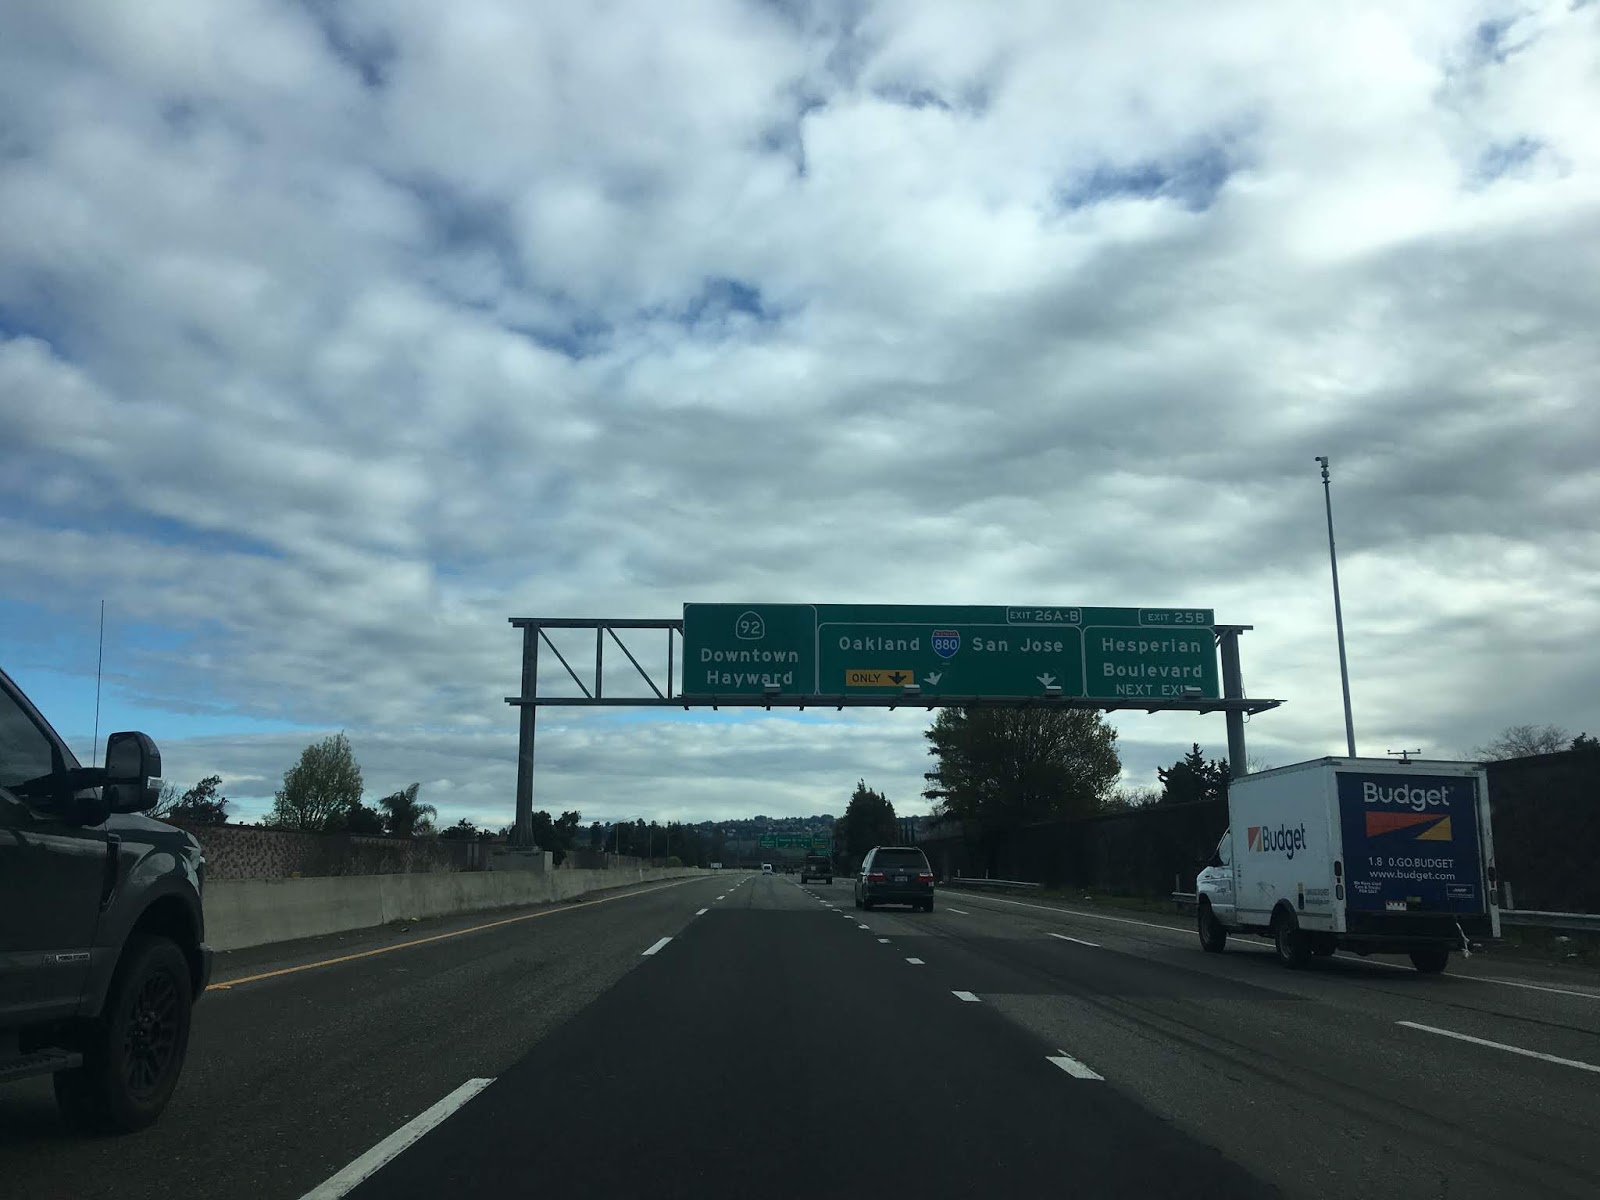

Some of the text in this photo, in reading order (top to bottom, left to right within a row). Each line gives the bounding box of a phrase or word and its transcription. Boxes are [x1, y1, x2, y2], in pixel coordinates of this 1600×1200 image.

[1010, 610, 1079, 622] EXIT 26A-B
[1147, 612, 1205, 623] EXIT 25B
[740, 620, 761, 635] 92
[838, 636, 1063, 655] Oakland 880 San Jose
[1102, 637, 1202, 655] Hesperian
[700, 648, 800, 663] Downtown
[1103, 662, 1203, 678] Boulevard
[706, 670, 794, 688] Hayward
[851, 673, 881, 684] ONLY
[1116, 684, 1191, 697] NEXT EXI
[1363, 781, 1450, 812] Budget
[1262, 823, 1307, 860] Budget
[1369, 869, 1456, 882] www.budget.com
